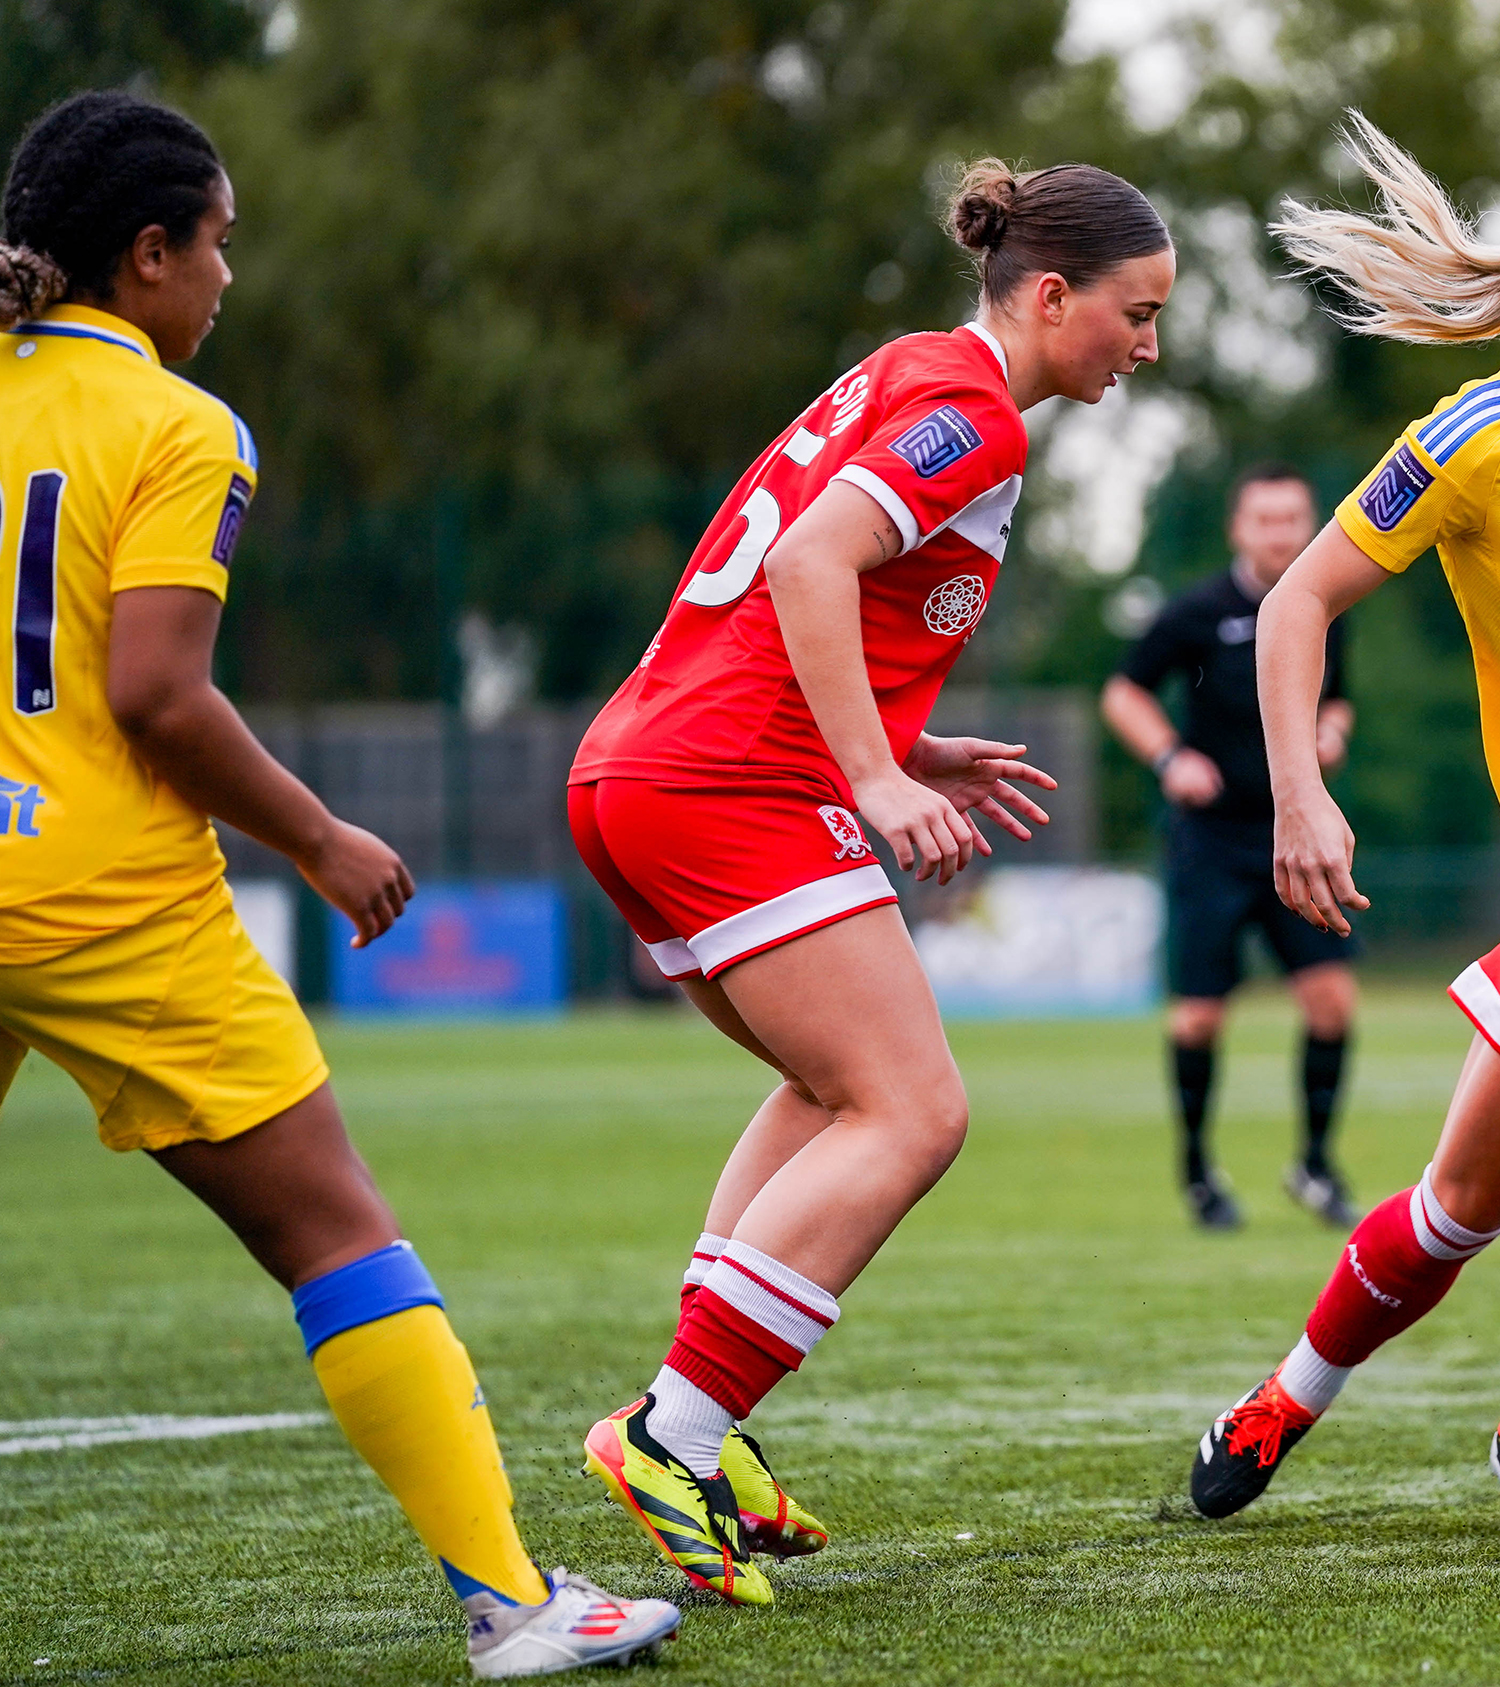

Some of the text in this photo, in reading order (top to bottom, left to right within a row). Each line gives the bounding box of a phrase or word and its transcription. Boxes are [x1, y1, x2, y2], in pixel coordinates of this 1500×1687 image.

[954, 418, 976, 444] Women's
[956, 427, 972, 449] League
[1406, 459, 1427, 483] Women's
[1407, 470, 1424, 489] League
[0, 468, 68, 717] 1
